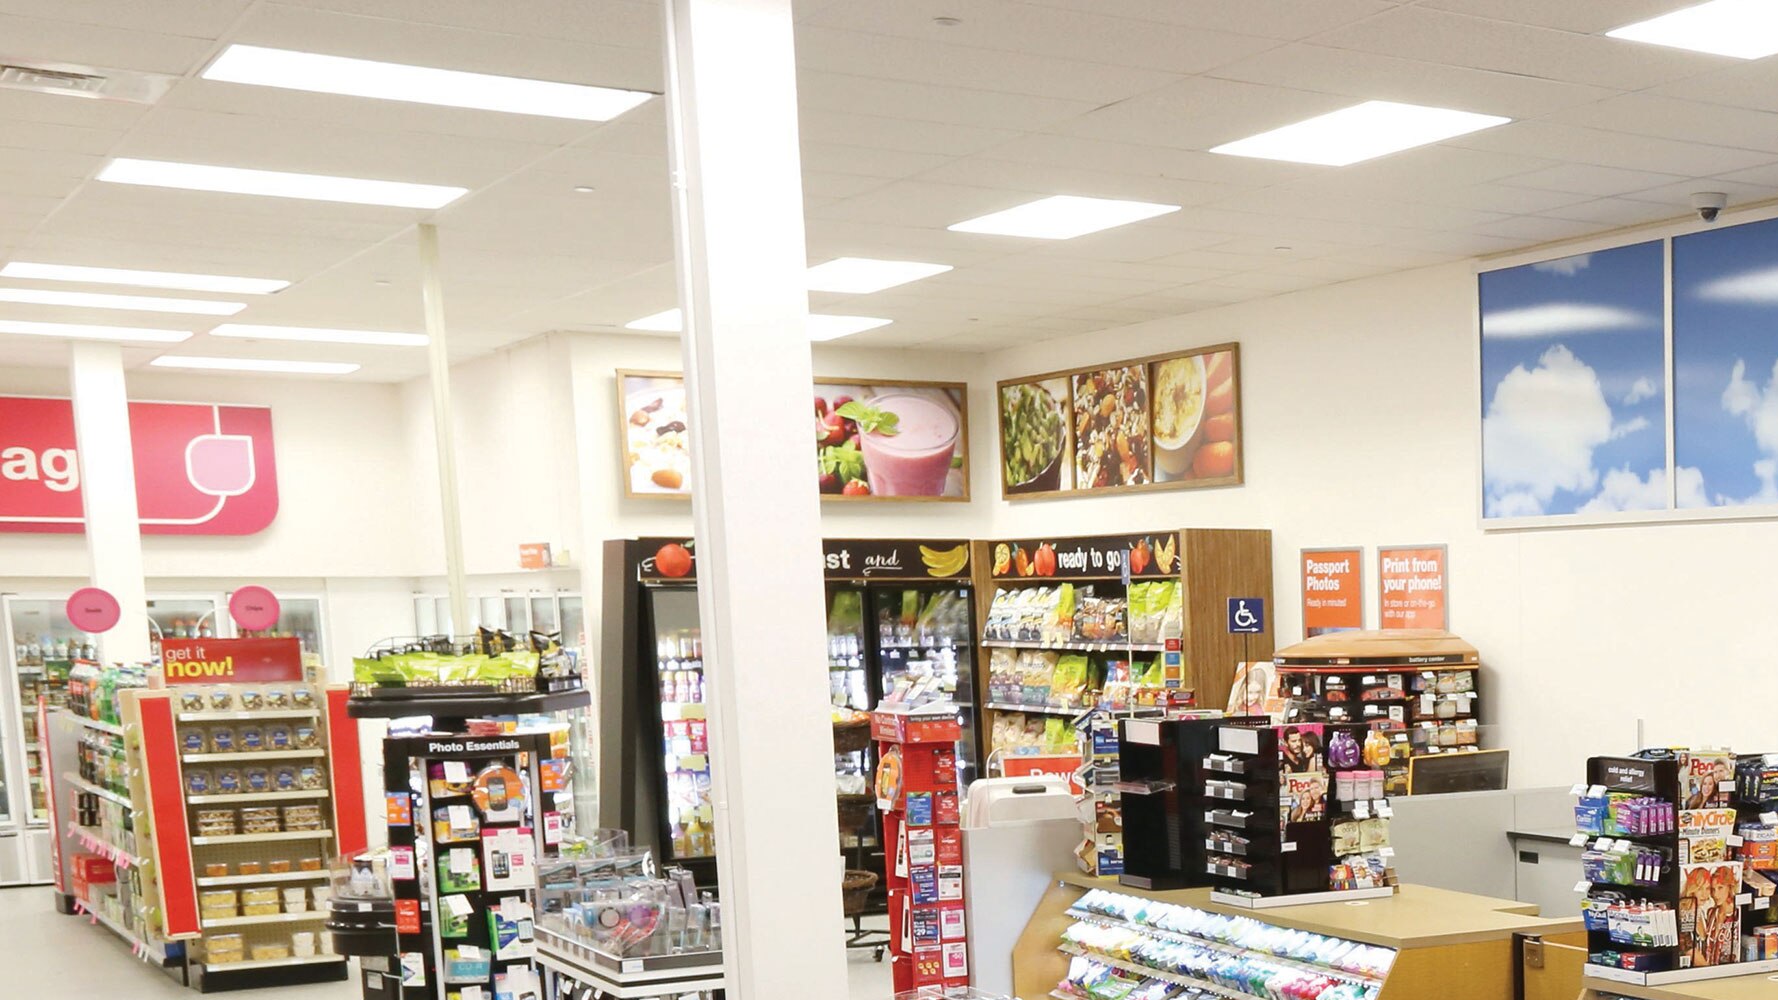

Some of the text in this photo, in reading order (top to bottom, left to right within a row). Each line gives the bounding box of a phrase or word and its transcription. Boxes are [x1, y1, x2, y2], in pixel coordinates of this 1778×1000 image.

[1058, 550, 1121, 576] ready to go
[1306, 559, 1350, 576] Passport
[1383, 557, 1437, 573] Print from
[1306, 576, 1340, 591] Photos
[1384, 575, 1442, 594] your phone!
[165, 646, 206, 663] get it
[1409, 656, 1427, 664] battery
[167, 656, 234, 678] now!
[428, 739, 520, 753] Photo Essentials
[1608, 767, 1619, 775] cold
[1629, 767, 1645, 778] allergy
[1620, 774, 1633, 783] relief
